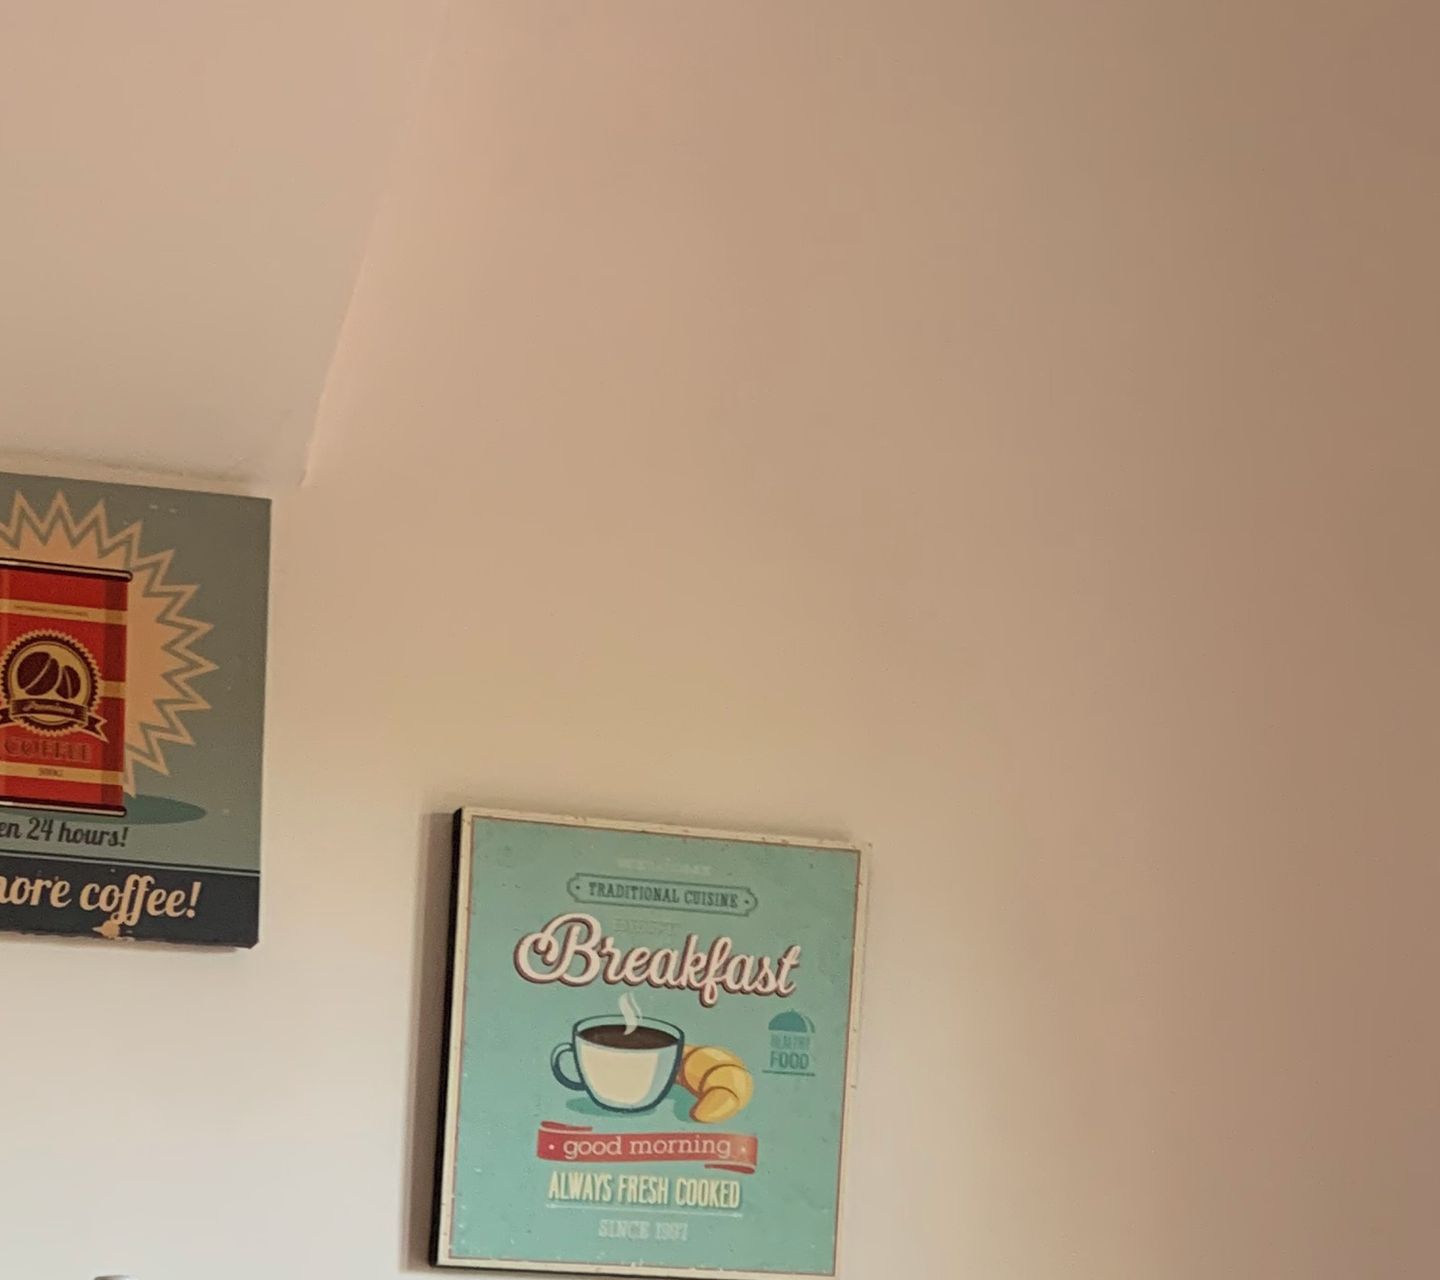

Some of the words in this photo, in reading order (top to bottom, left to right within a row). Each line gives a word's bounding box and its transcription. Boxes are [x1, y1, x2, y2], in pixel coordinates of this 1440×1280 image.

[26, 816, 55, 843] 24
[58, 820, 128, 849] hours!
[78, 872, 203, 927] coffee!
[588, 881, 680, 904] TRADITIONAL
[684, 889, 739, 909] CUISINE
[513, 912, 802, 1009] Breakfast
[769, 1050, 810, 1070] FOOD
[562, 1136, 622, 1160] good
[629, 1134, 732, 1159] morning
[548, 1170, 612, 1202] ALWAYS
[616, 1174, 670, 1205] FRESH
[674, 1177, 742, 1209] COOKED
[598, 1218, 651, 1241] SINCE
